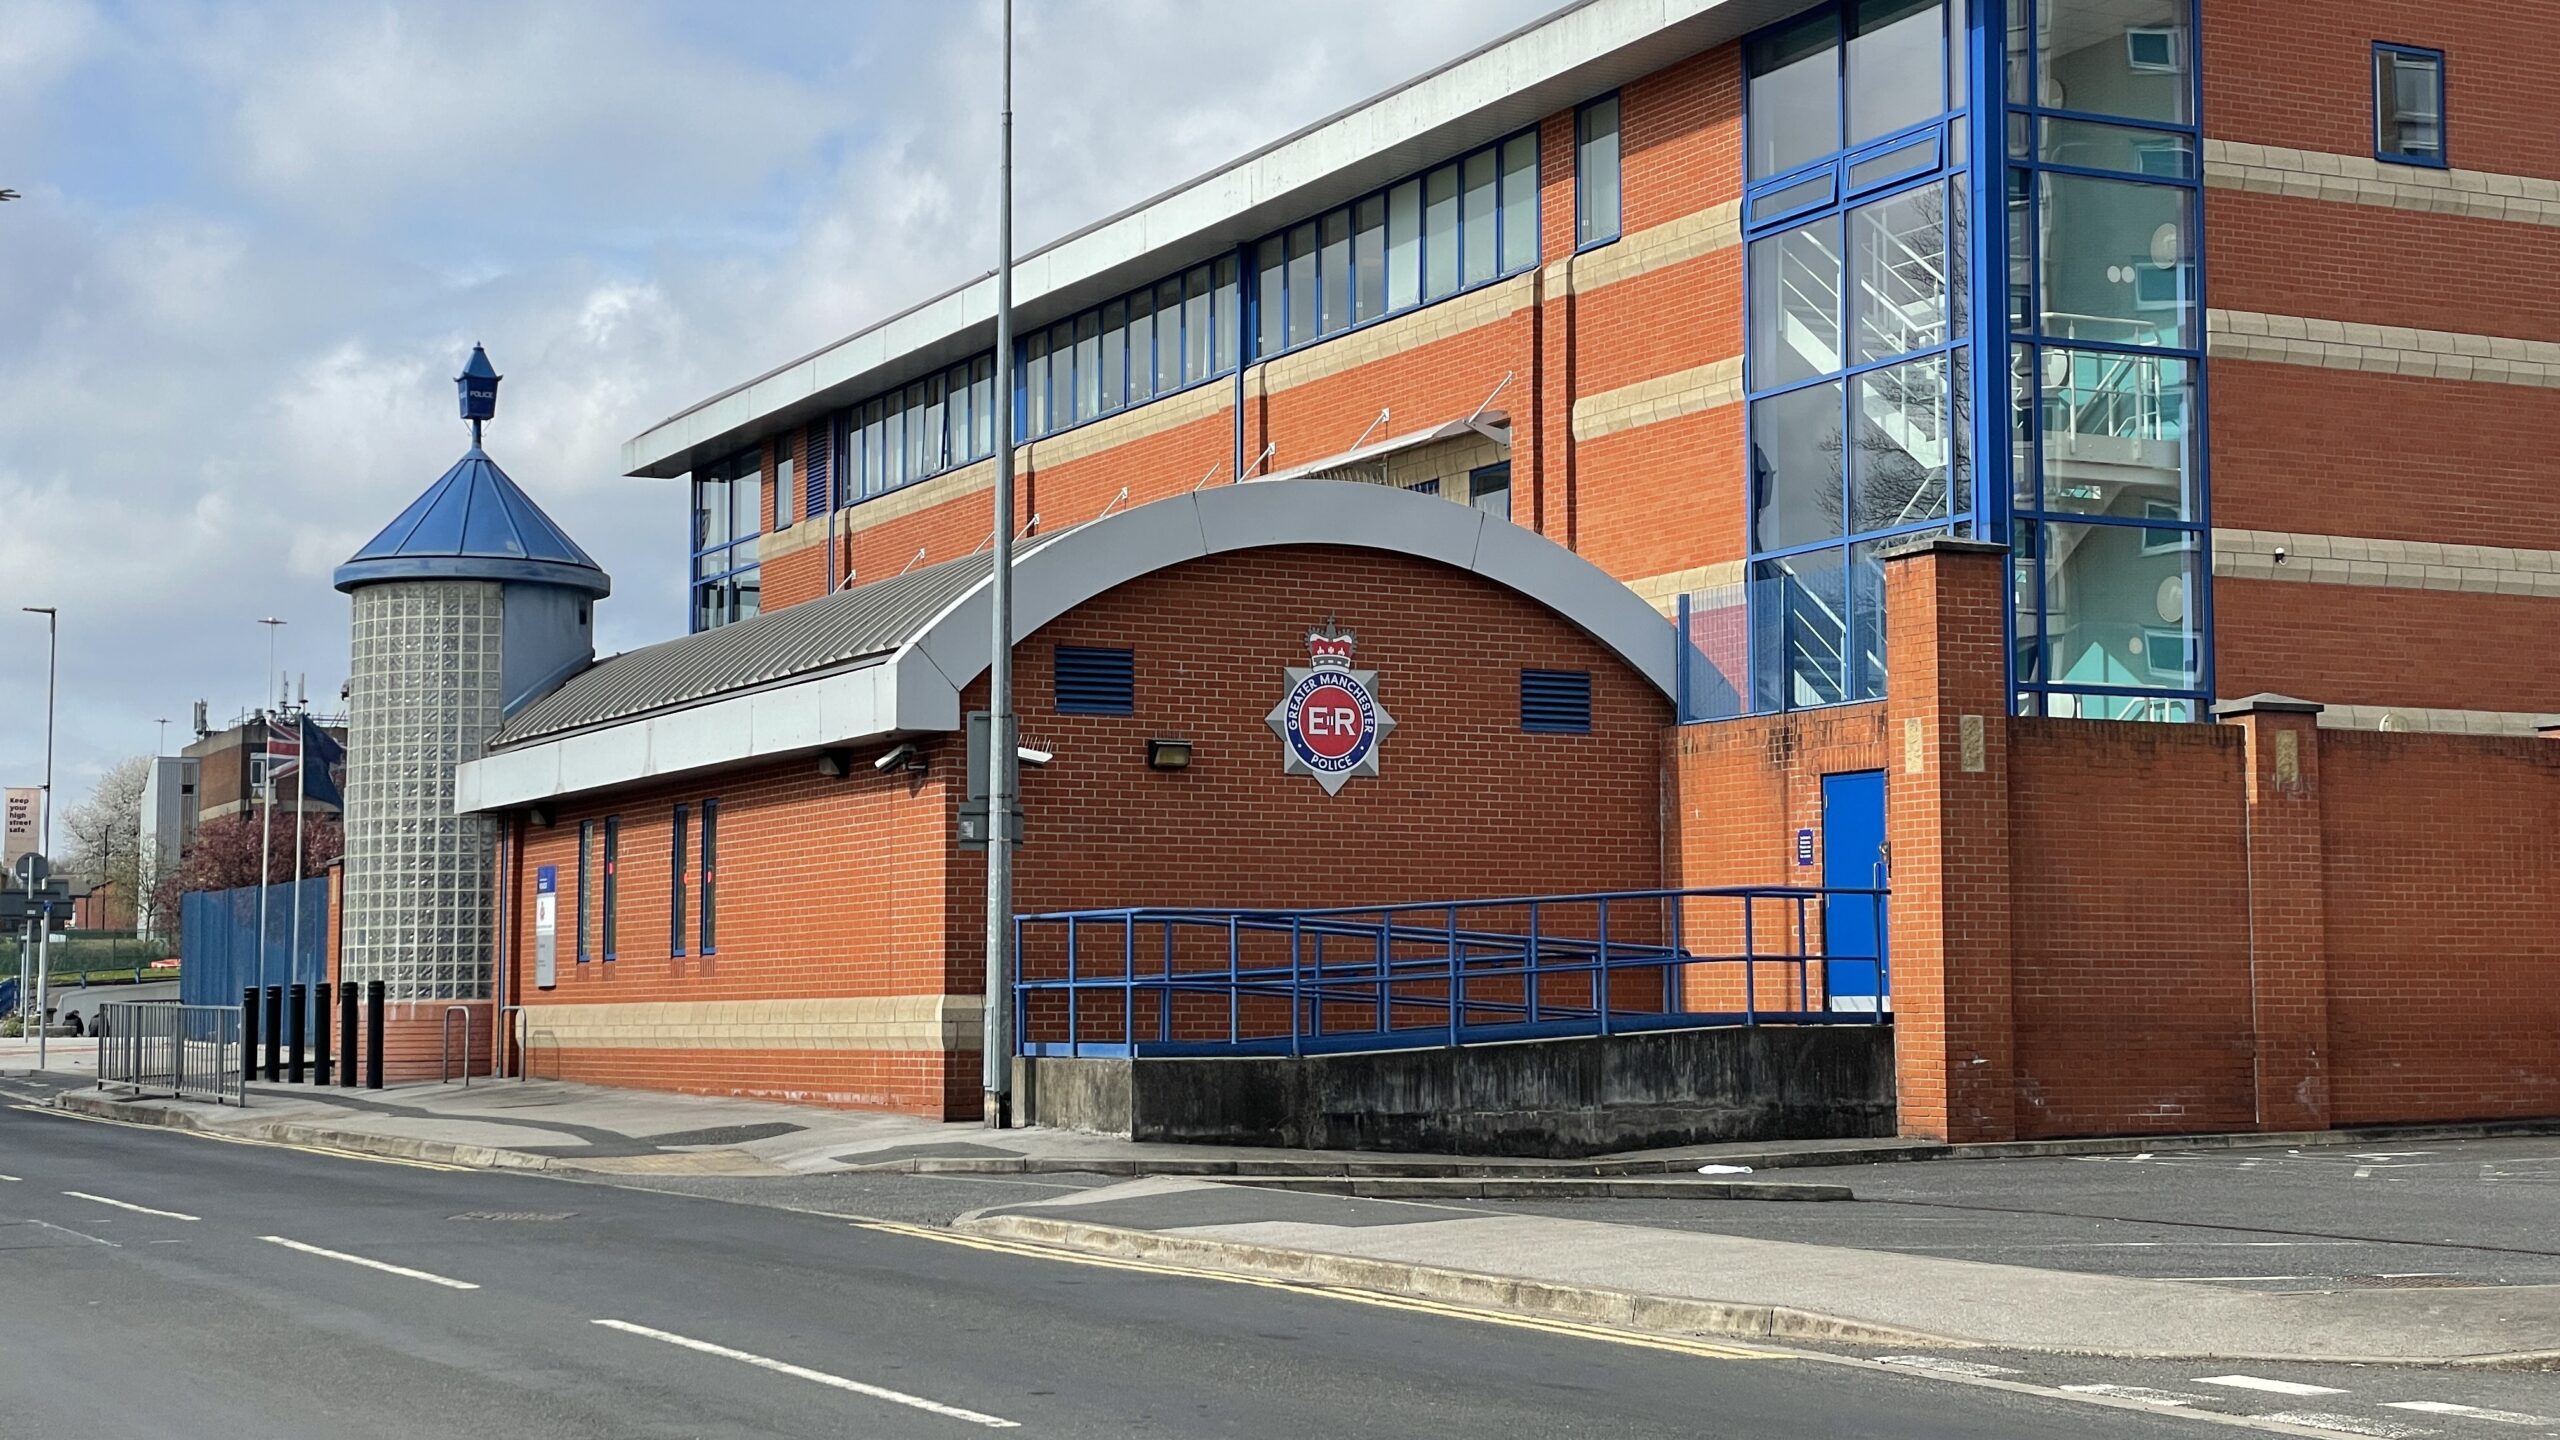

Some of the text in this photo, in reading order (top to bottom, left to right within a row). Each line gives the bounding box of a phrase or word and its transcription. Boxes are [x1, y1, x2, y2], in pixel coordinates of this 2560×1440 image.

[470, 390, 494, 399] POLICE
[1288, 673, 1374, 734] GREATER MANCHESTER
[1310, 754, 1353, 771] POLICE
[9, 797, 30, 805] Keep
[9, 812, 27, 820] high
